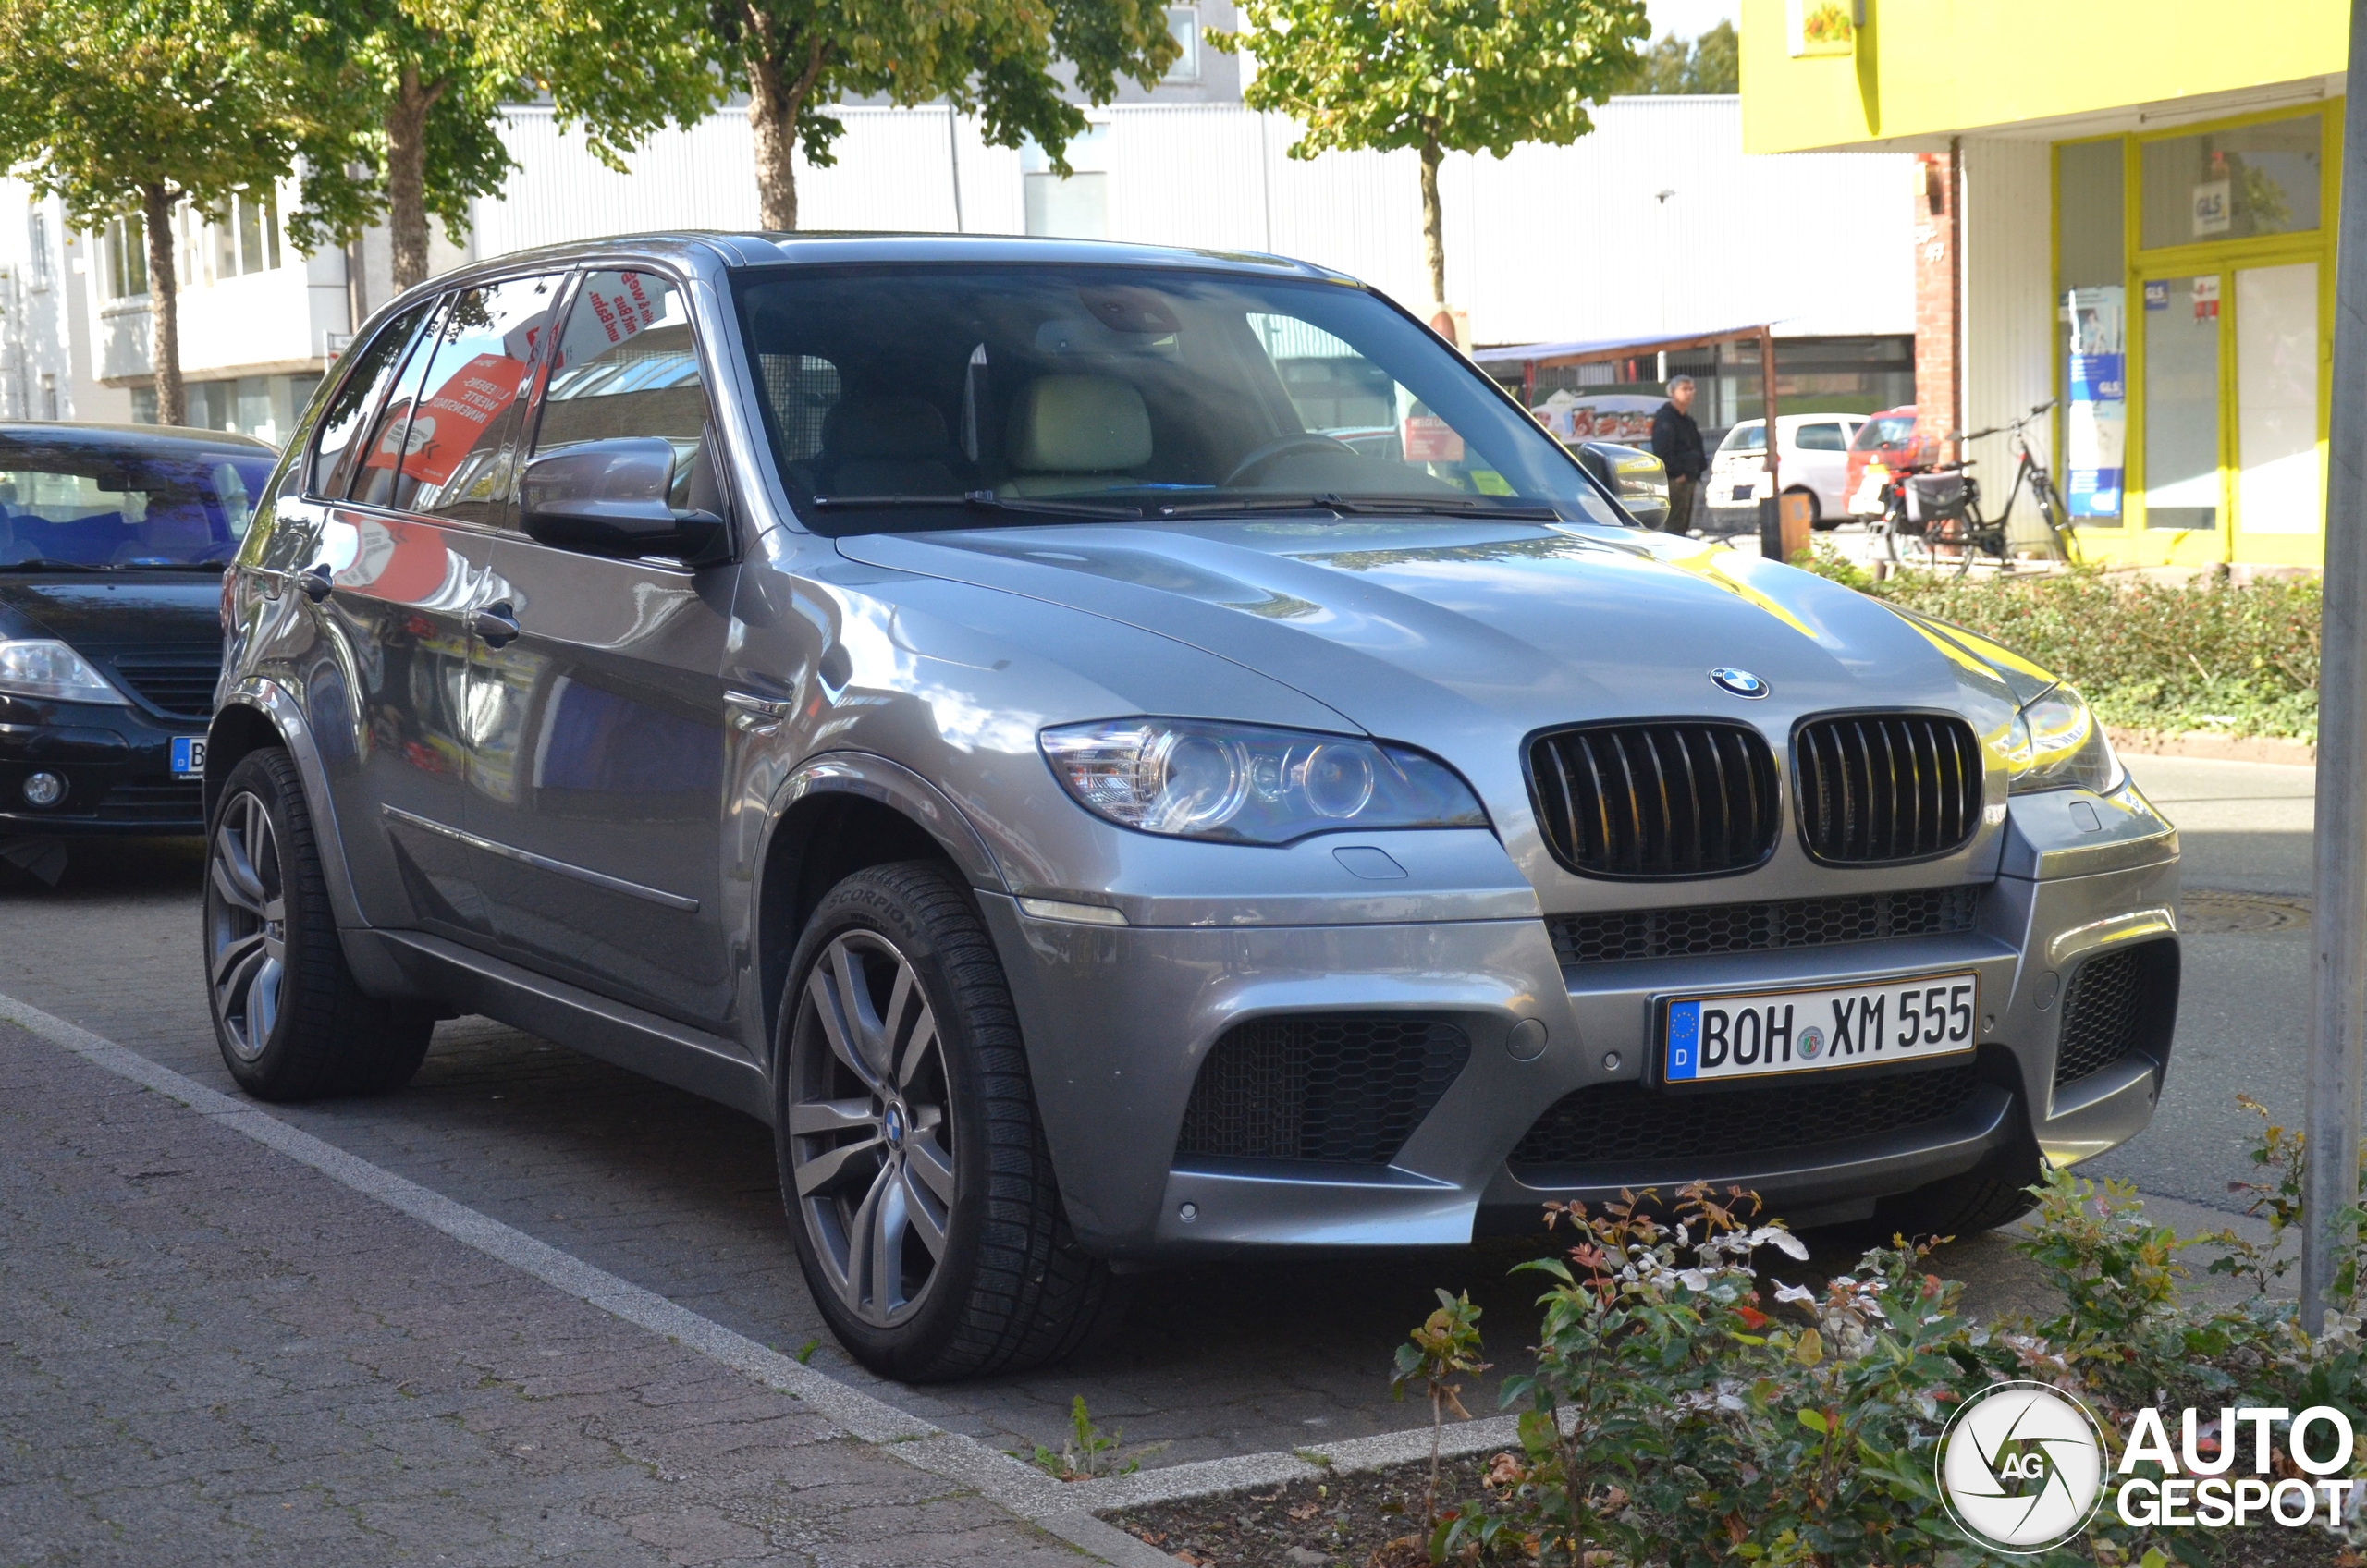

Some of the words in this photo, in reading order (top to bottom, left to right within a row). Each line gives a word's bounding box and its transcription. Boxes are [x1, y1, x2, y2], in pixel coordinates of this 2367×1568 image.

[2196, 193, 2221, 217] GLS
[191, 742, 205, 767] B
[828, 888, 919, 940] SCORPION
[1699, 1004, 1794, 1069] BOH
[1828, 994, 1886, 1057] XM
[1898, 985, 1971, 1047] 555
[1675, 1048, 1688, 1066] D
